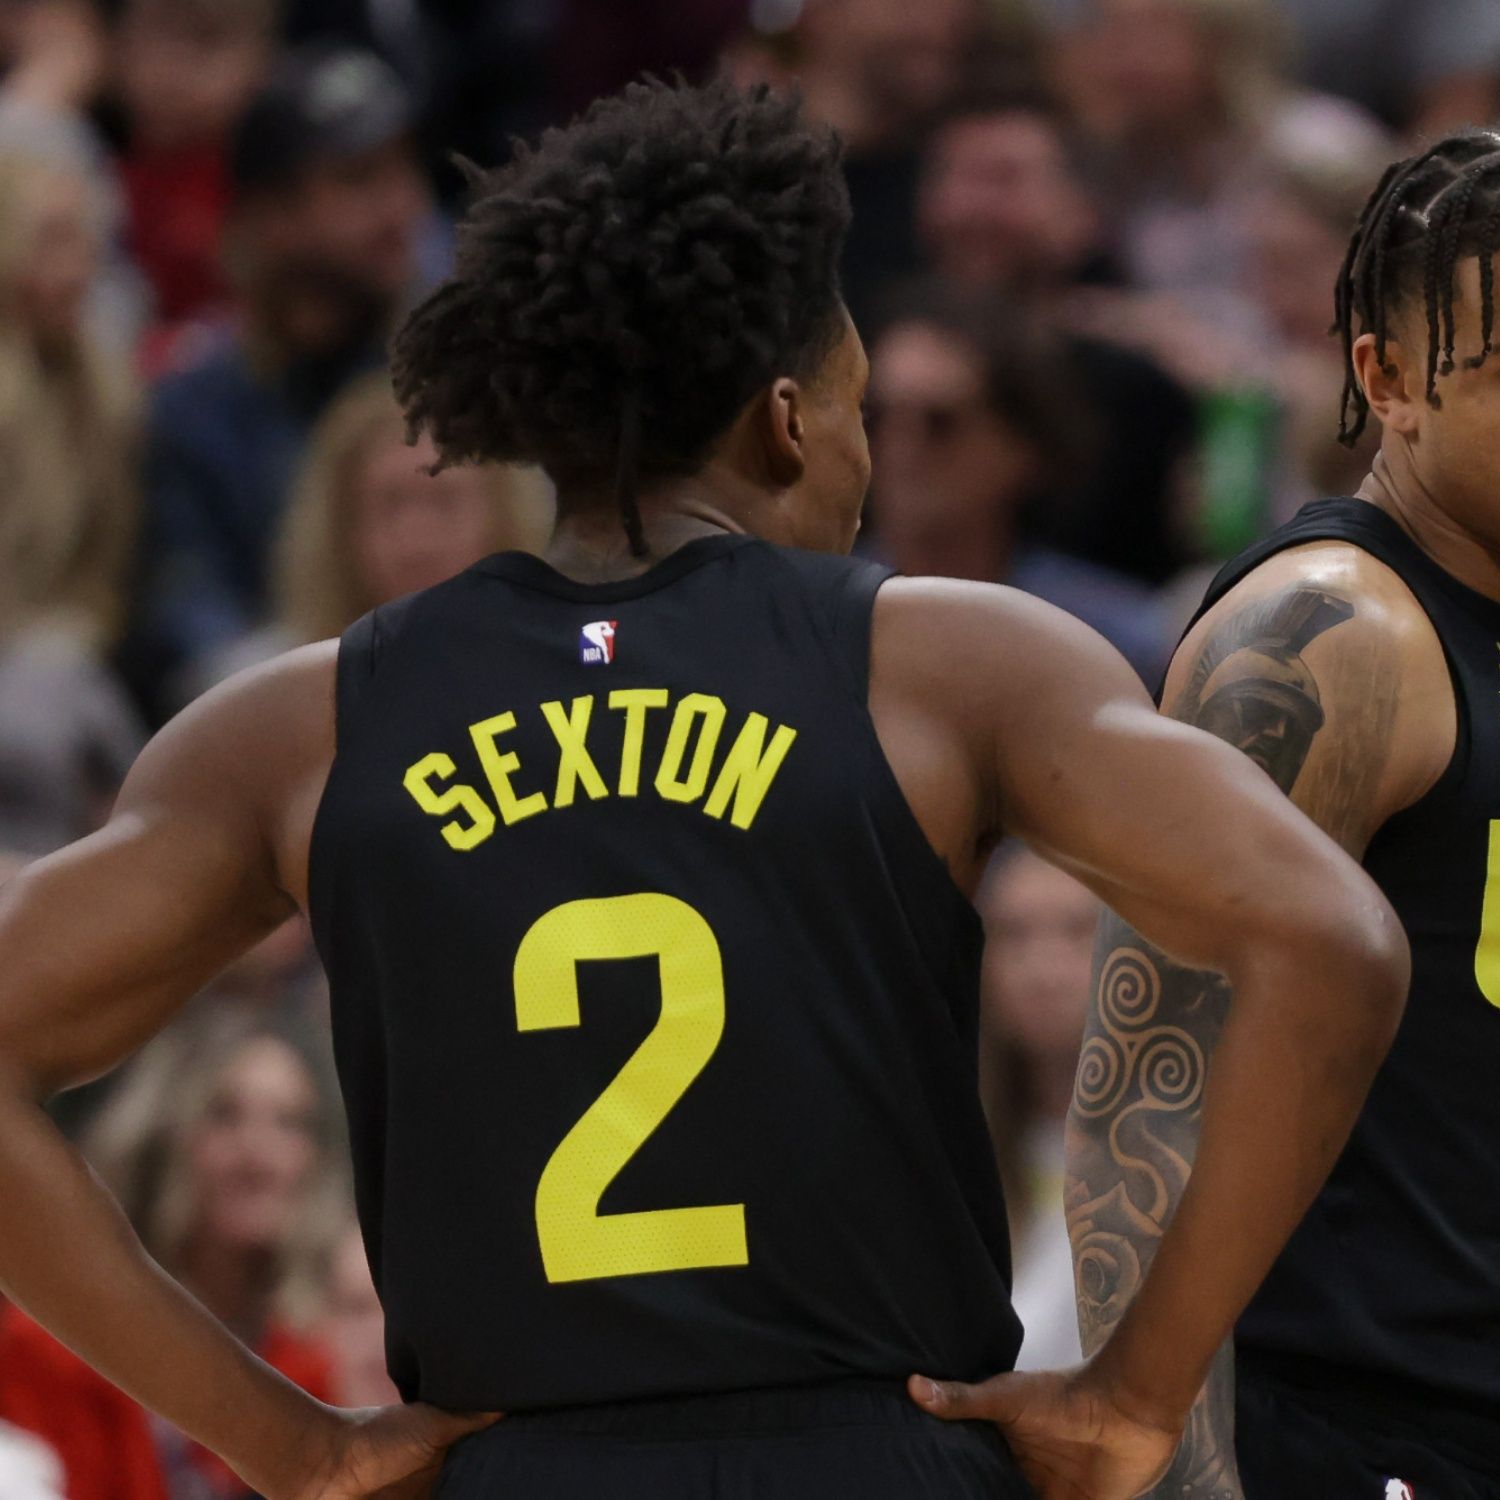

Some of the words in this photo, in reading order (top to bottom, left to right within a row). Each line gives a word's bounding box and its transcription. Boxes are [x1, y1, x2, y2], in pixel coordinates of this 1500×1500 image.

[583, 646, 602, 662] NBA
[402, 688, 797, 851] SEXTON
[512, 892, 749, 1284] 2
